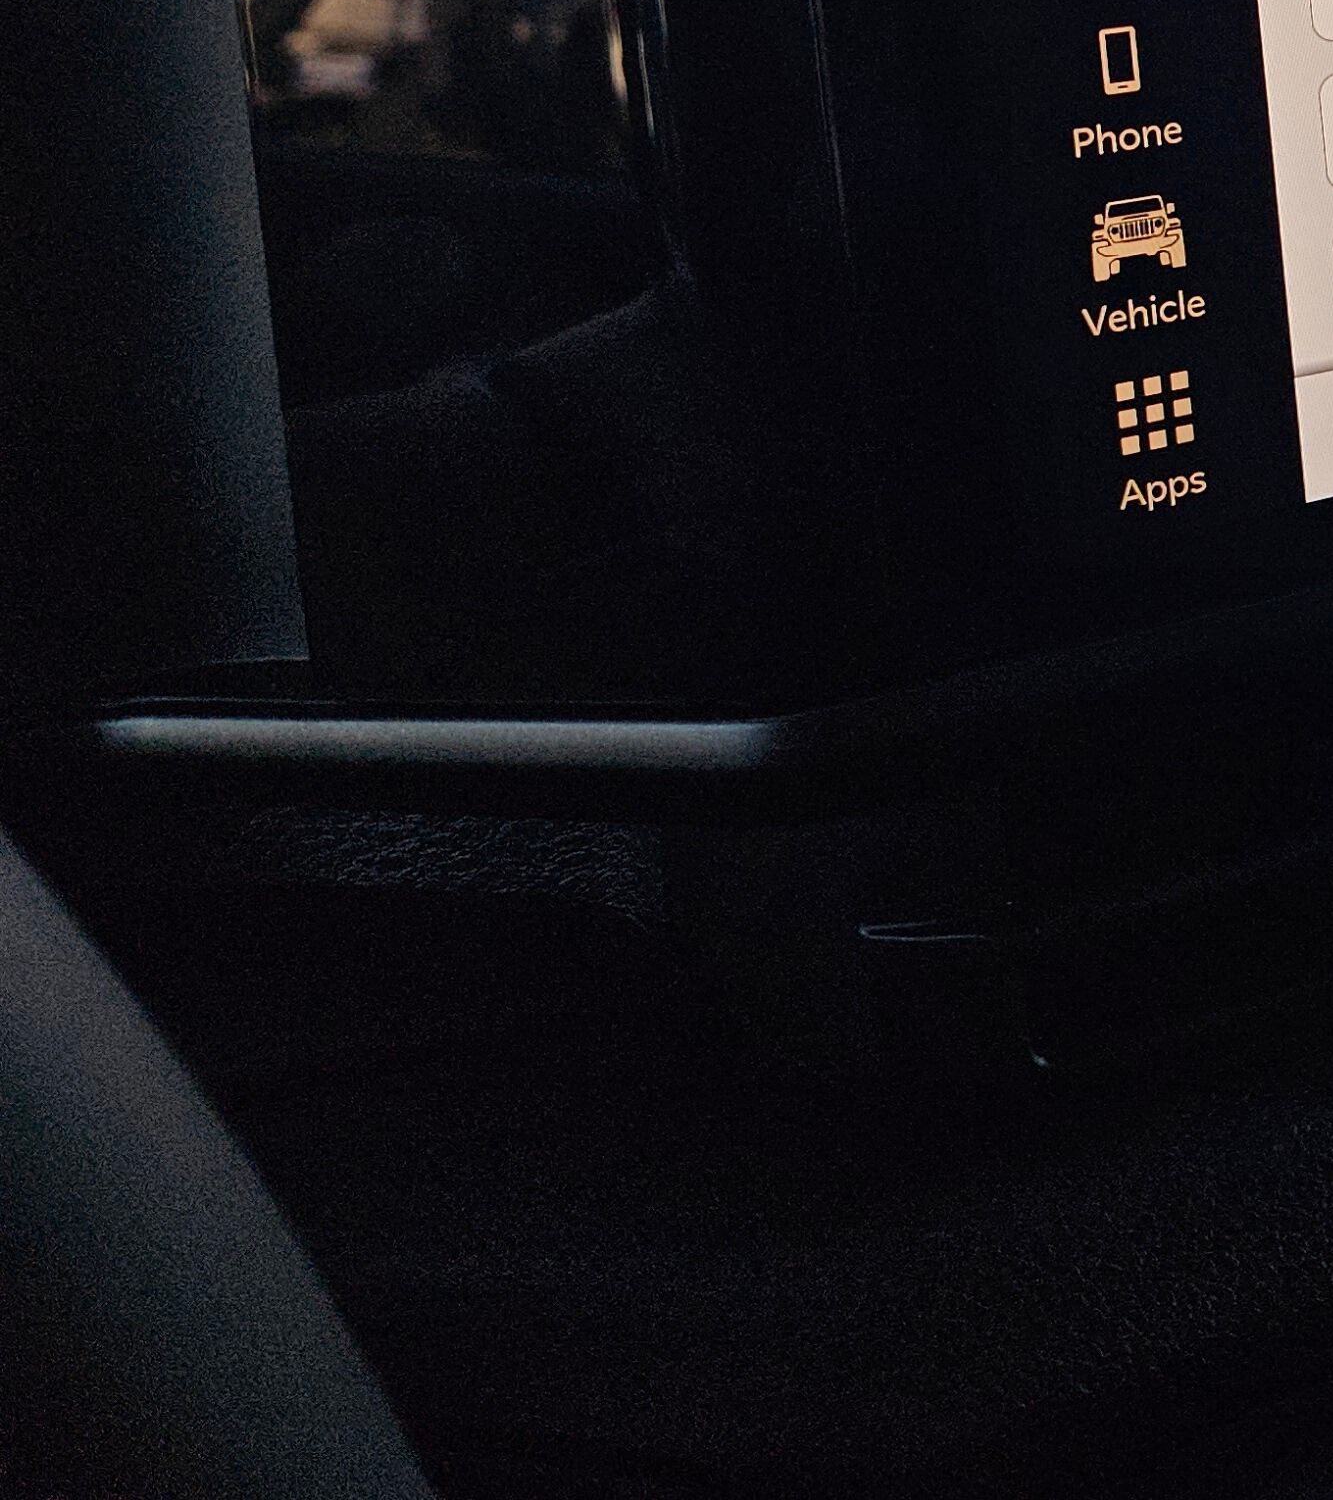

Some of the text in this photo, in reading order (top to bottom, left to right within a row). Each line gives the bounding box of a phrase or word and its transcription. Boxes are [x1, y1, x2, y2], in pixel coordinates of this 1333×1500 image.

[1073, 119, 1183, 157] Phone
[1082, 291, 1206, 337] Vehicle
[1120, 470, 1207, 509] Apps
